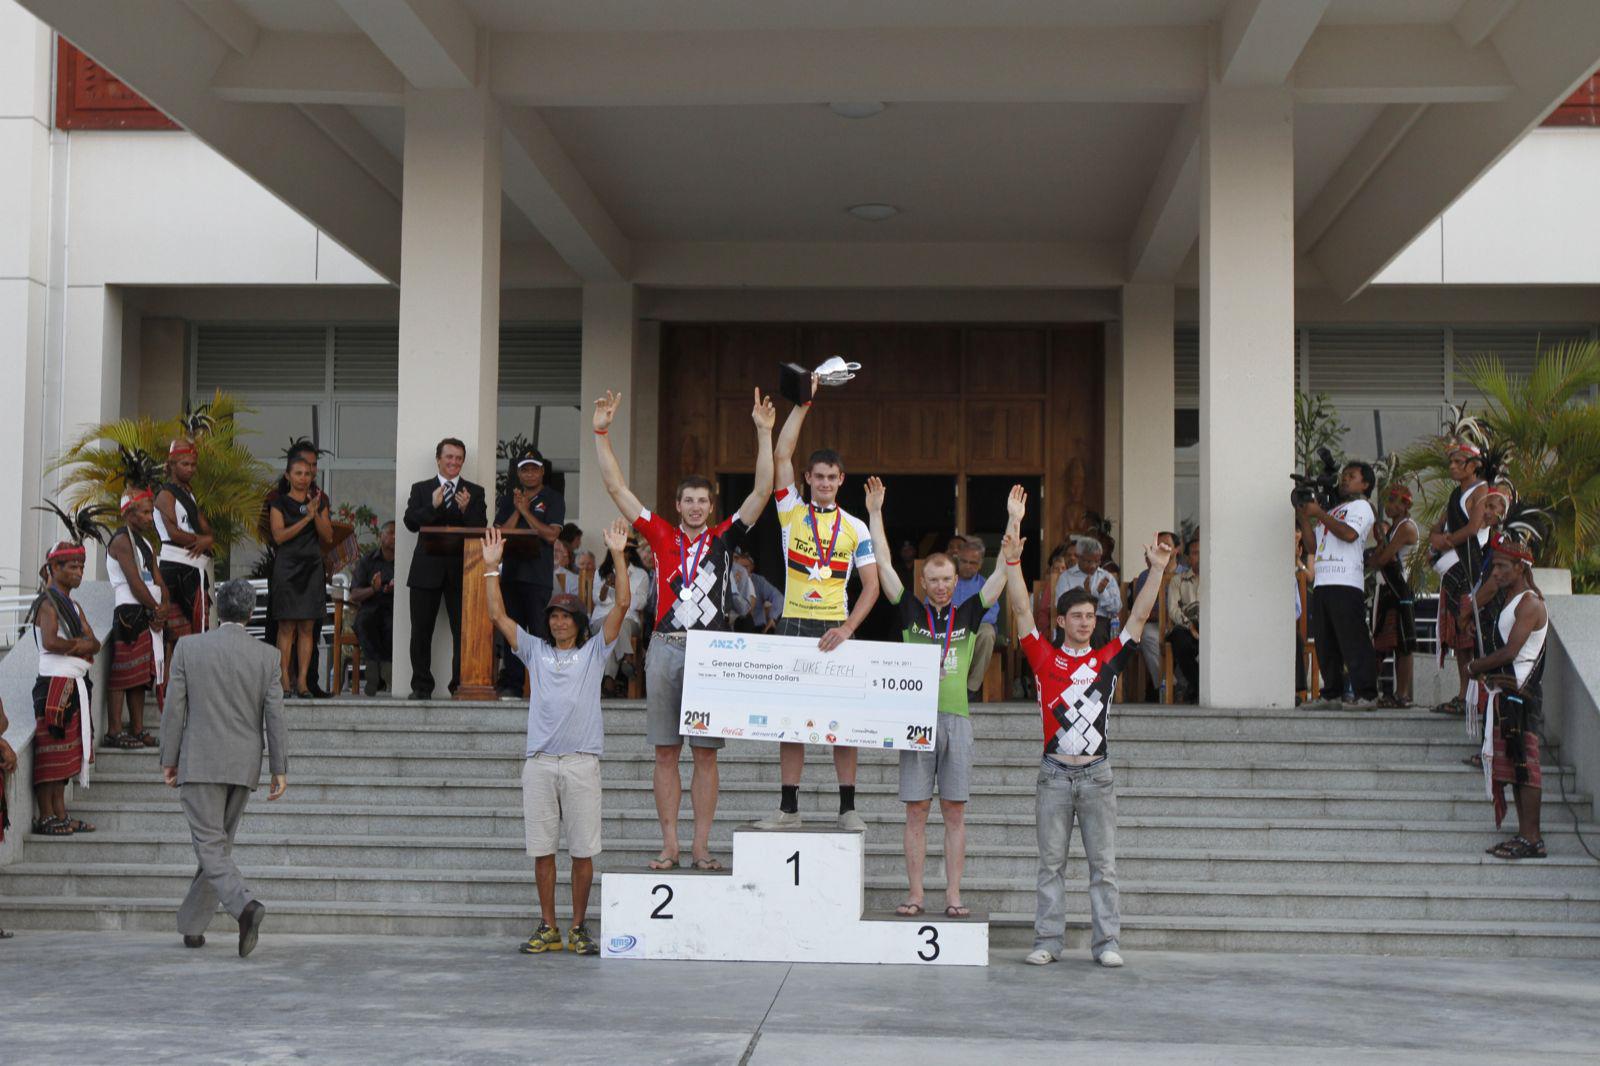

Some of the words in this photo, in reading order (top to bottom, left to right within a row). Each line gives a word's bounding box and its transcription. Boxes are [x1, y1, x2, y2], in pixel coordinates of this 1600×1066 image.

[794, 537, 814, 554] Tour
[709, 639, 733, 649] ANZ
[712, 660, 742, 669] General
[744, 661, 783, 671] Champion
[793, 658, 821, 674] LUKE
[723, 671, 735, 679] Ten
[737, 671, 773, 681] Thousand
[775, 674, 800, 682] Dollars
[881, 678, 923, 692] 10,000
[684, 710, 710, 727] 2011
[906, 725, 932, 741] 2011
[786, 850, 800, 886] 1
[650, 884, 674, 919] 2
[916, 925, 941, 962] 3
